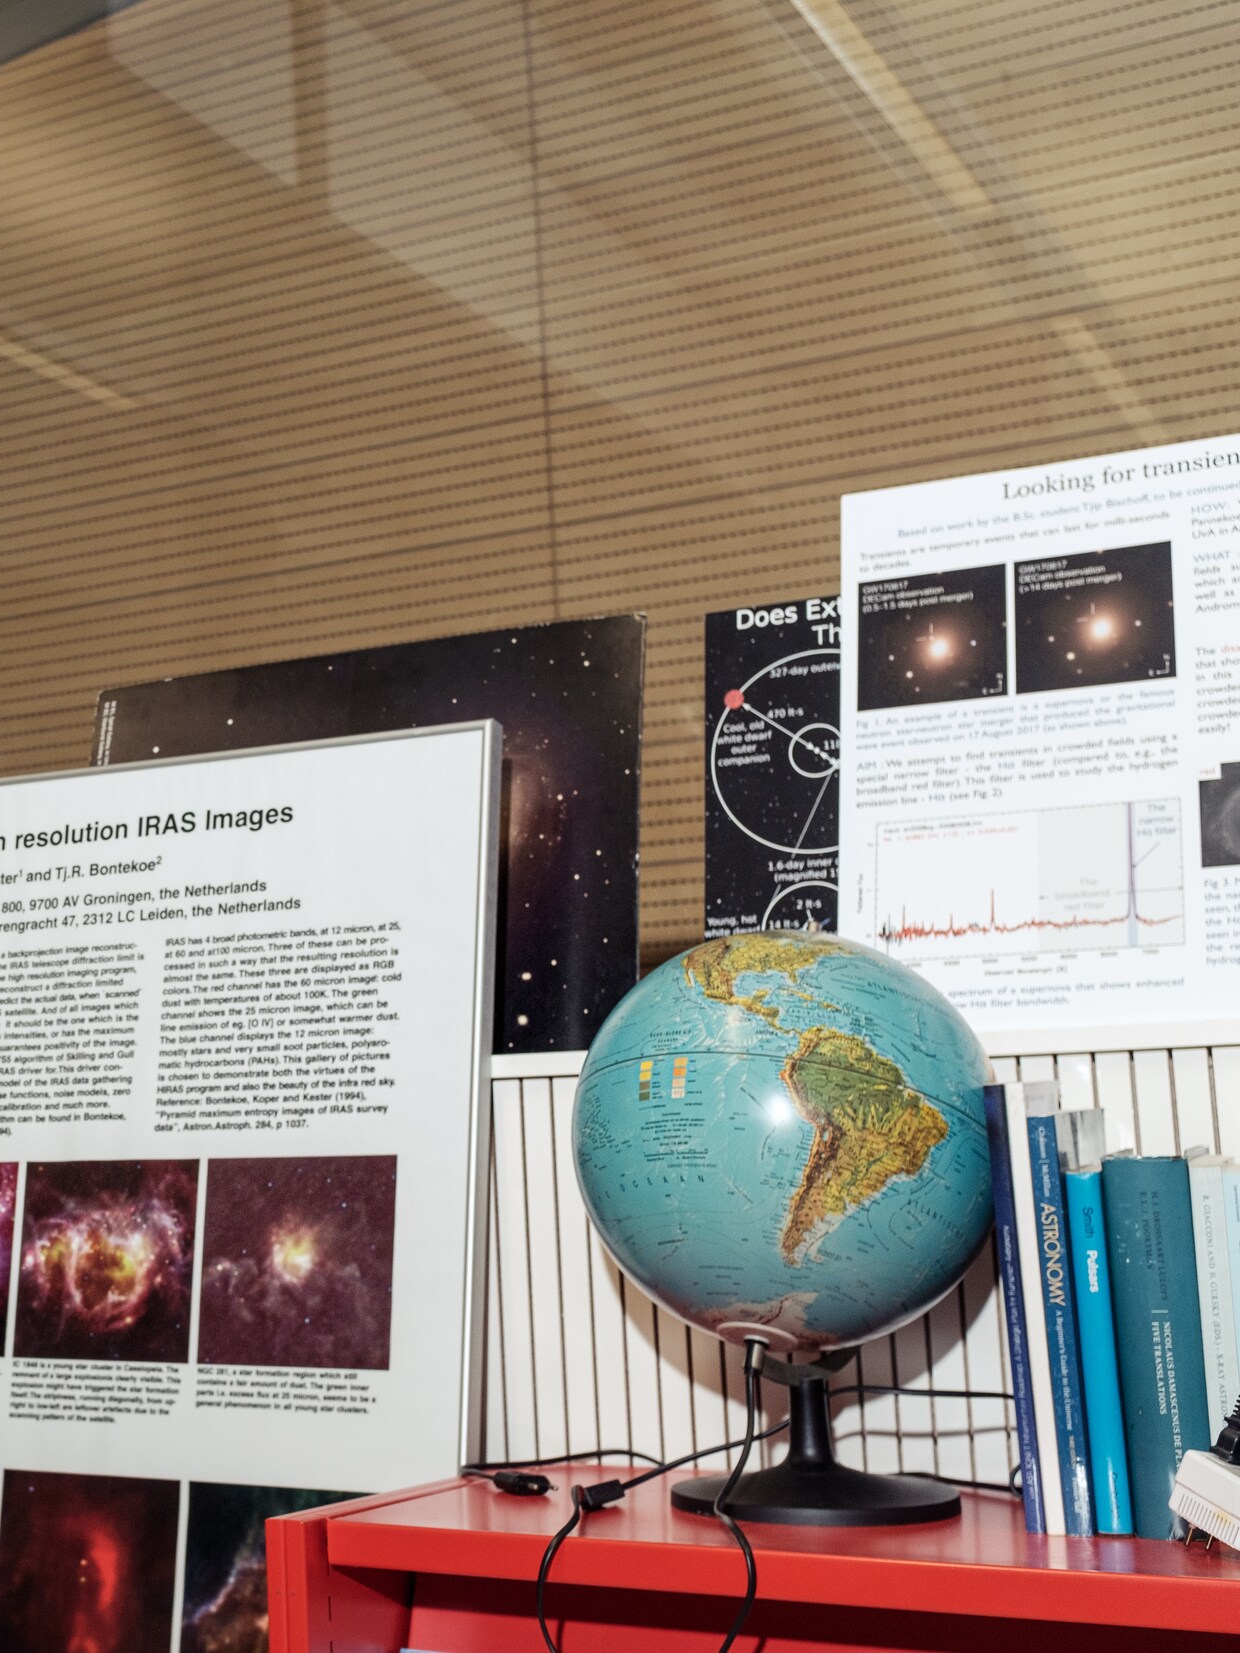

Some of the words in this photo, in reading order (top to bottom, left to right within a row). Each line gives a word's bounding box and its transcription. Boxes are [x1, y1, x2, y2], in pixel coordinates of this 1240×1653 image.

[1003, 474, 1094, 499] Looking
[1102, 466, 1135, 484] for
[736, 606, 798, 630] Does
[716, 734, 743, 746] white
[744, 730, 772, 743] dwarf
[723, 722, 747, 734] Cool,
[749, 720, 765, 731] old
[718, 753, 771, 768] companion
[731, 744, 757, 756] outer
[15, 821, 127, 849] resolution
[138, 811, 195, 837] IRAS
[205, 806, 293, 831] Images
[26, 868, 51, 882] and
[55, 865, 84, 882] Tj.R.
[807, 857, 833, 868] inner
[1, 900, 25, 913] 800,
[29, 897, 58, 911] 9700
[62, 895, 79, 907] AV
[83, 891, 154, 906] Groningen,
[159, 887, 180, 899] the
[184, 879, 266, 897] Netherlands
[61, 914, 78, 926] 47,
[82, 912, 113, 925] 2312
[117, 909, 134, 922] LC
[140, 907, 187, 921] Leiden,
[191, 904, 213, 916] the
[218, 897, 300, 915] Netherlands
[163, 974, 192, 982] almost
[195, 973, 208, 981] the
[211, 972, 236, 980] same.
[239, 969, 265, 977] These
[311, 962, 355, 974] displayed
[372, 959, 394, 969] RGB
[161, 999, 181, 1007] dust
[203, 995, 260, 1005] temperatures
[262, 993, 272, 1001] of
[274, 992, 300, 1000] about
[331, 989, 348, 997] The
[351, 988, 378, 998] green
[199, 1033, 234, 1042] channel
[236, 1032, 274, 1041] displays
[295, 1029, 305, 1038] 12
[184, 1058, 244, 1069] hydrocarbons
[283, 1055, 302, 1063] This
[305, 1054, 336, 1064] gallery
[339, 1052, 348, 1061] of
[351, 1052, 390, 1062] pictures
[168, 1073, 199, 1081] chosen
[213, 1070, 269, 1079] demonstrate
[272, 1068, 292, 1077] both
[295, 1068, 310, 1076] the
[348, 1065, 357, 1073] of
[360, 1065, 375, 1073] the
[252, 1095, 279, 1104] Koper
[282, 1094, 299, 1102] and
[302, 1093, 332, 1101] Kester
[1083, 1206, 1095, 1239] Smith
[1040, 1203, 1065, 1306] ASTRONOMY
[1087, 1250, 1099, 1293] Pulsars
[1152, 1321, 1161, 1343] FIVE
[1163, 1322, 1174, 1369] NICOLAUS
[1154, 1345, 1167, 1415] TRANSLATIONS
[1060, 1354, 1068, 1377] Guide
[1065, 1398, 1073, 1431] Universe
[1168, 1371, 1180, 1433] DAMASCENUS
[1174, 1435, 1181, 1448] DE
